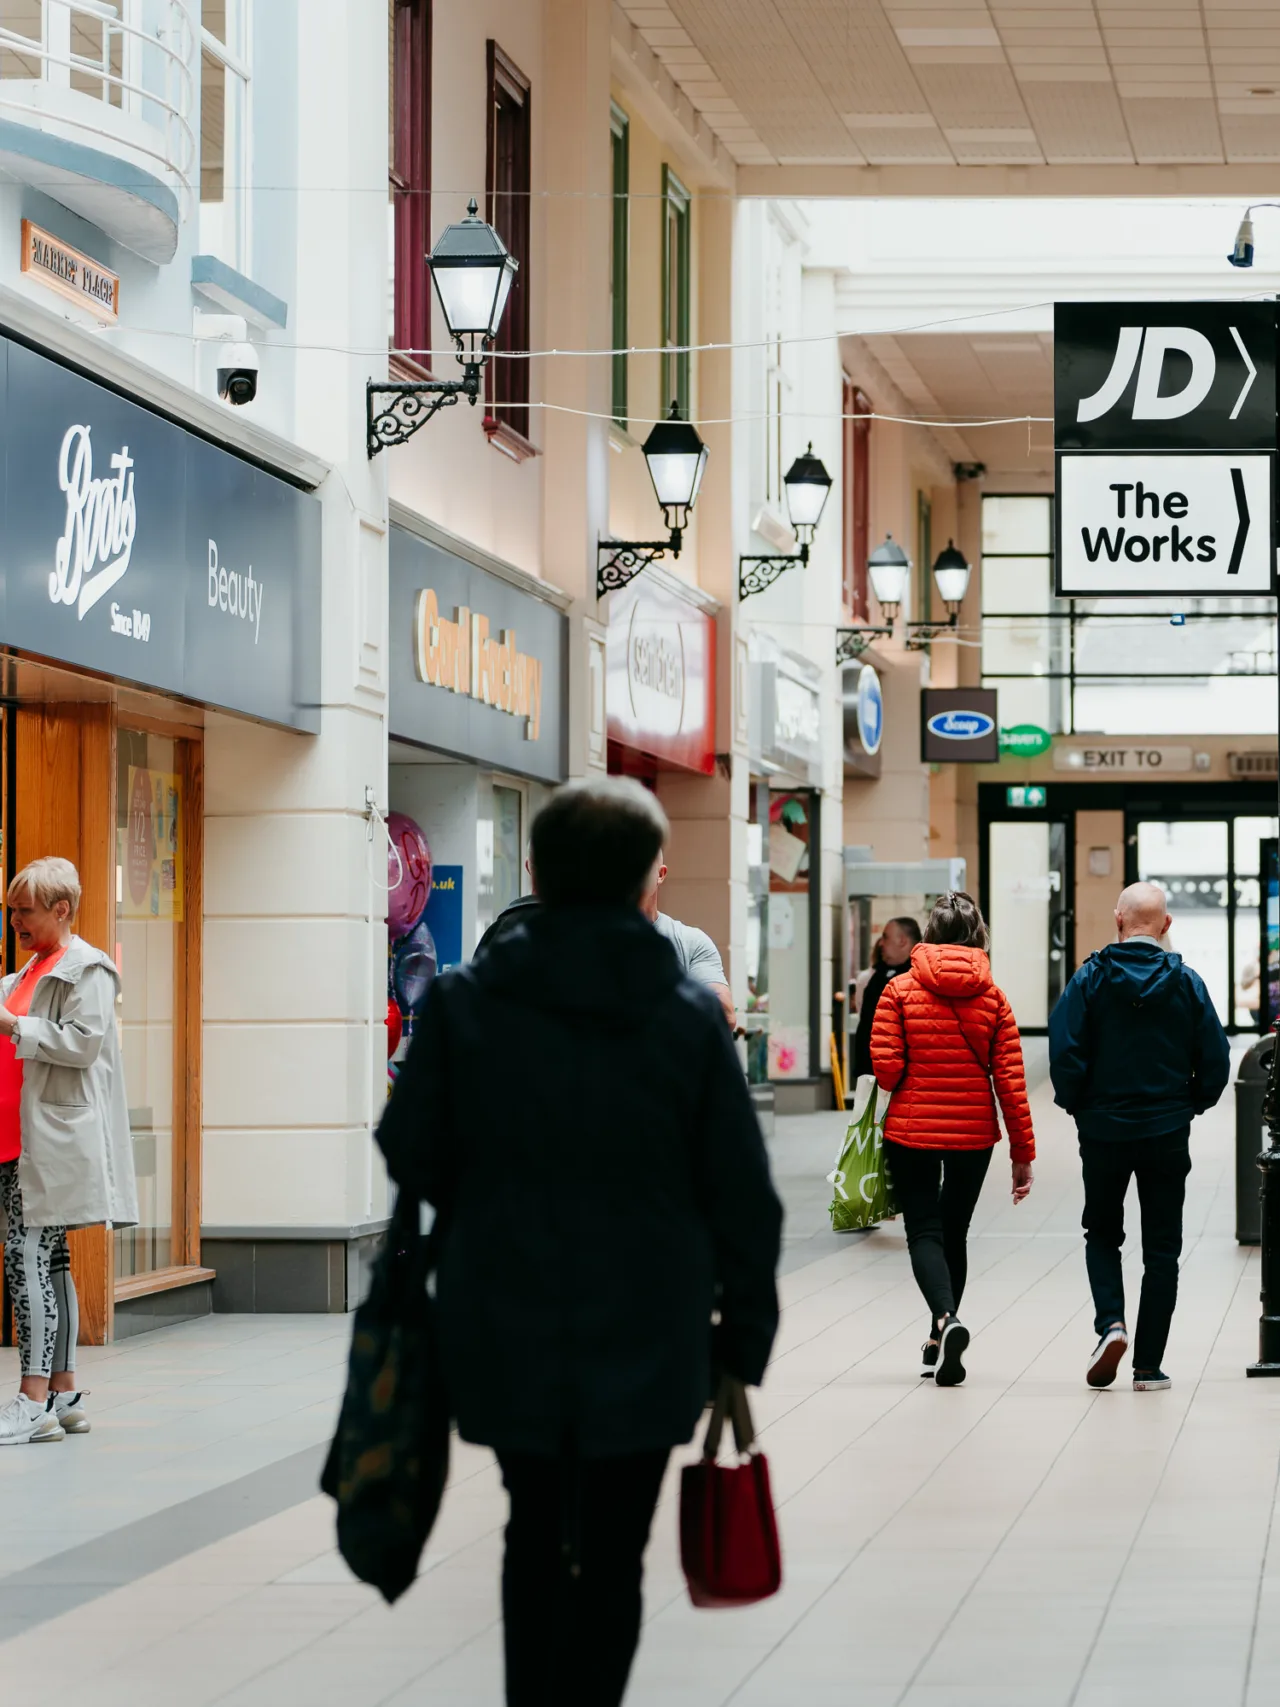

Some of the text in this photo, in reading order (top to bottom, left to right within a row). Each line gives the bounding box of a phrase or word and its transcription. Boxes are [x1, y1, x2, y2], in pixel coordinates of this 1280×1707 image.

[32, 238, 114, 306] MARKET PLACE
[1076, 326, 1216, 423] JD
[49, 424, 137, 621] Boots
[1109, 481, 1189, 519] The
[1081, 525, 1217, 563] Works
[208, 539, 263, 645] Beauty
[110, 602, 132, 637] Since
[1083, 750, 1162, 767] EXIT TO
